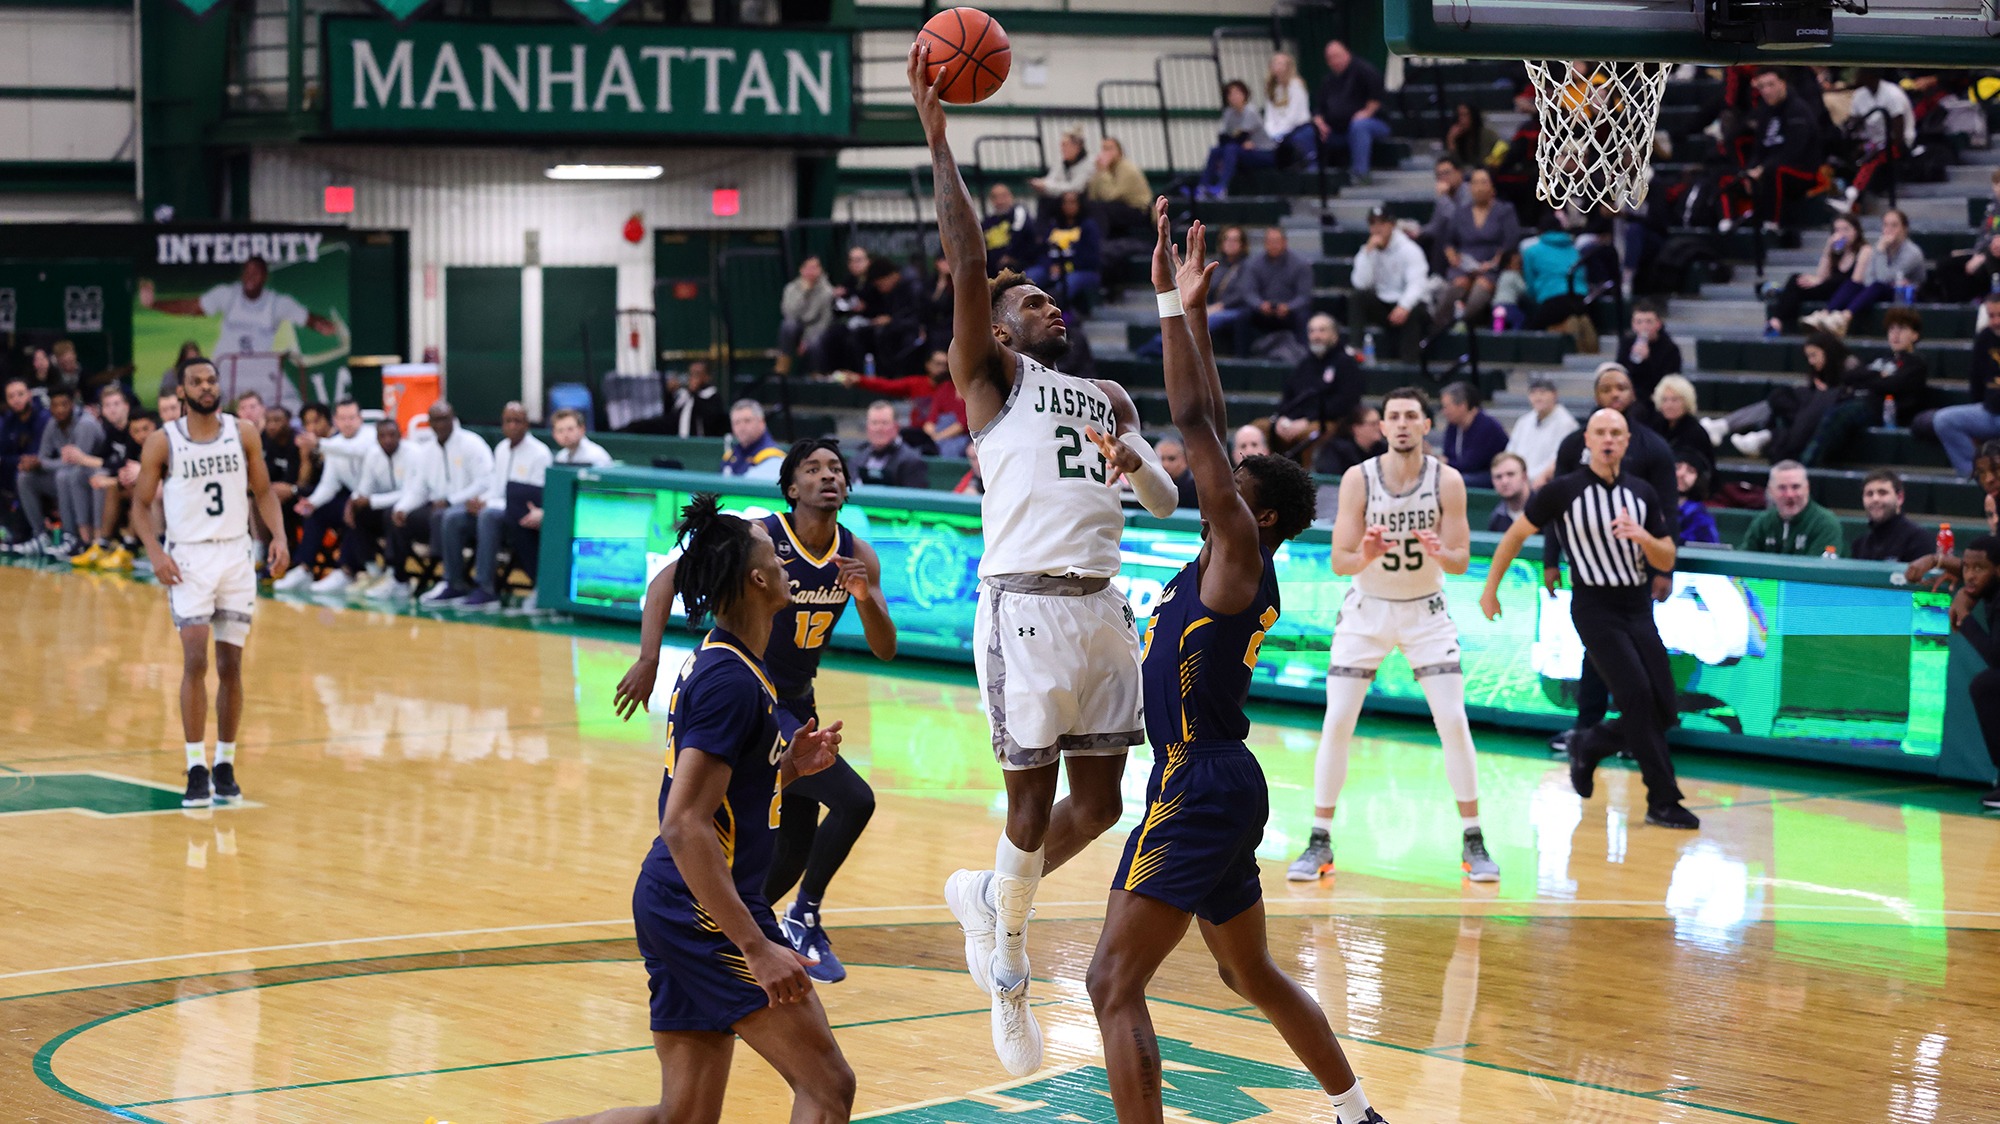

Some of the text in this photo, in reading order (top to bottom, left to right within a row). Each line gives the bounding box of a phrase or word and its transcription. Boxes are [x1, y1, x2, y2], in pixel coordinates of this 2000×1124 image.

[351, 39, 833, 116] MANHATTAN
[156, 232, 323, 265] INTEGRITY
[1034, 385, 1116, 436] JASPERS
[182, 453, 239, 479] JASPERS
[1054, 424, 1107, 486] 23
[204, 481, 225, 516] 3
[1370, 509, 1436, 533] JASPERS
[1382, 537, 1424, 572] 55
[787, 579, 850, 605] Canisius
[793, 610, 835, 650] 12
